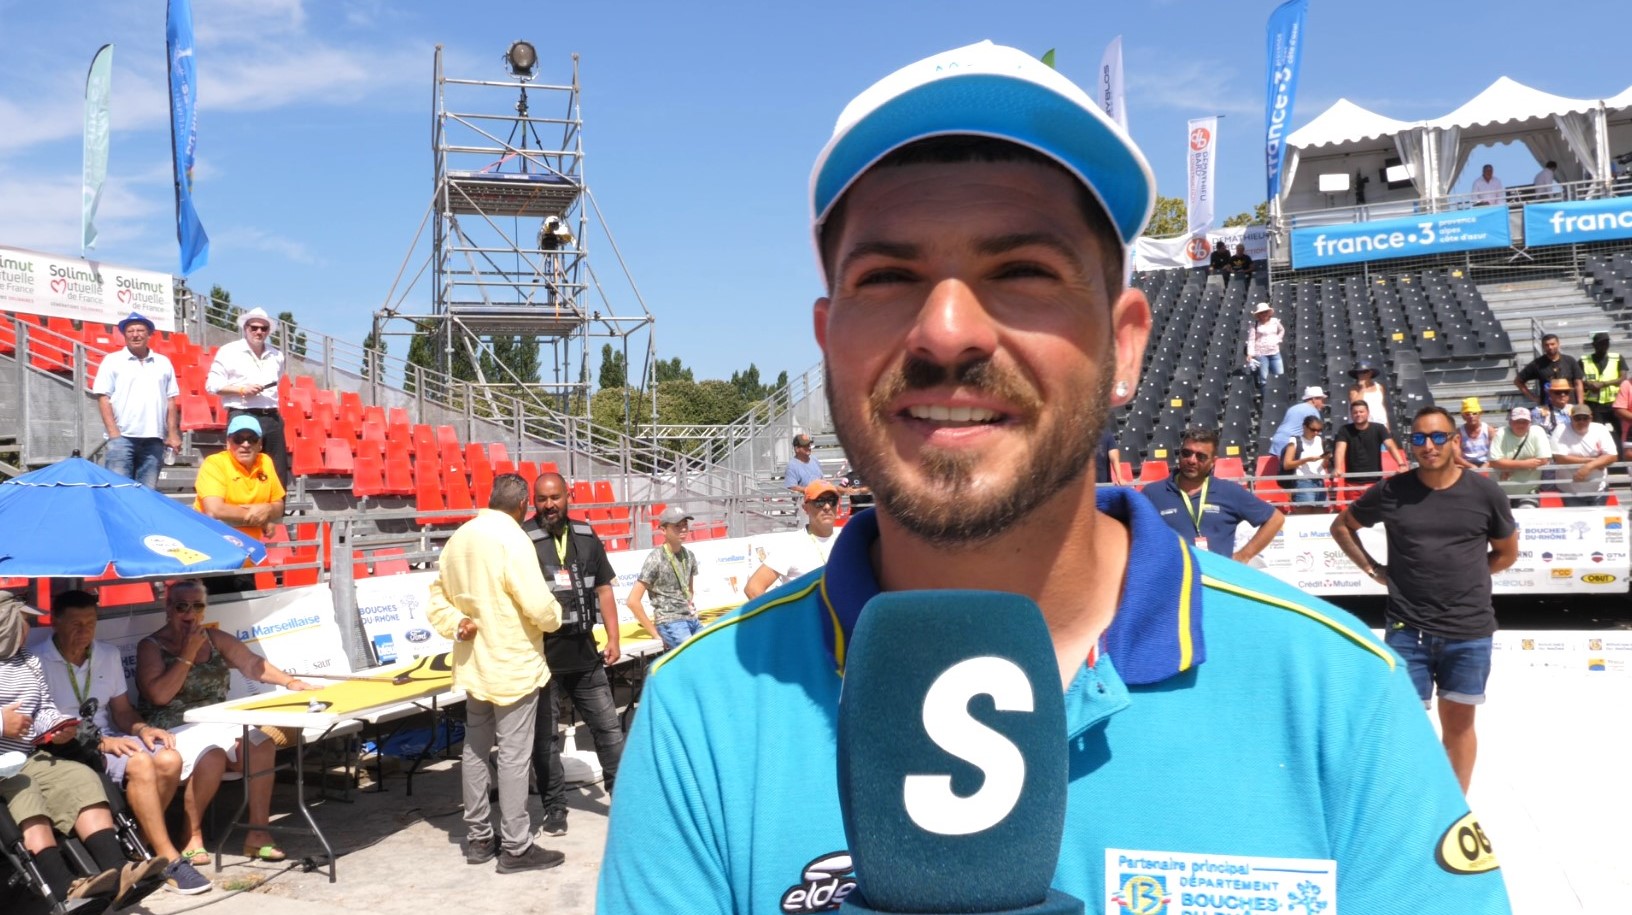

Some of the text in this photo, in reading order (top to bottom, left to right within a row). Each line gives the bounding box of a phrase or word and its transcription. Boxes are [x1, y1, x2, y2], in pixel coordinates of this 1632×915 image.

[1200, 151, 1209, 202] DEMATHIEU
[1549, 210, 1632, 234] franc
[0, 254, 34, 273] imut
[0, 270, 34, 285] tuelle
[50, 264, 103, 284] Solimut
[117, 275, 164, 294] Solimut
[67, 291, 77, 301] de
[132, 301, 142, 310] de
[1333, 580, 1361, 588] Mutuel
[251, 615, 321, 638] Marseillaise
[312, 658, 331, 670] saur
[903, 656, 1034, 835] S
[1458, 821, 1492, 861] OB
[1118, 855, 1250, 875] Partenaire principal
[783, 878, 857, 909] elde
